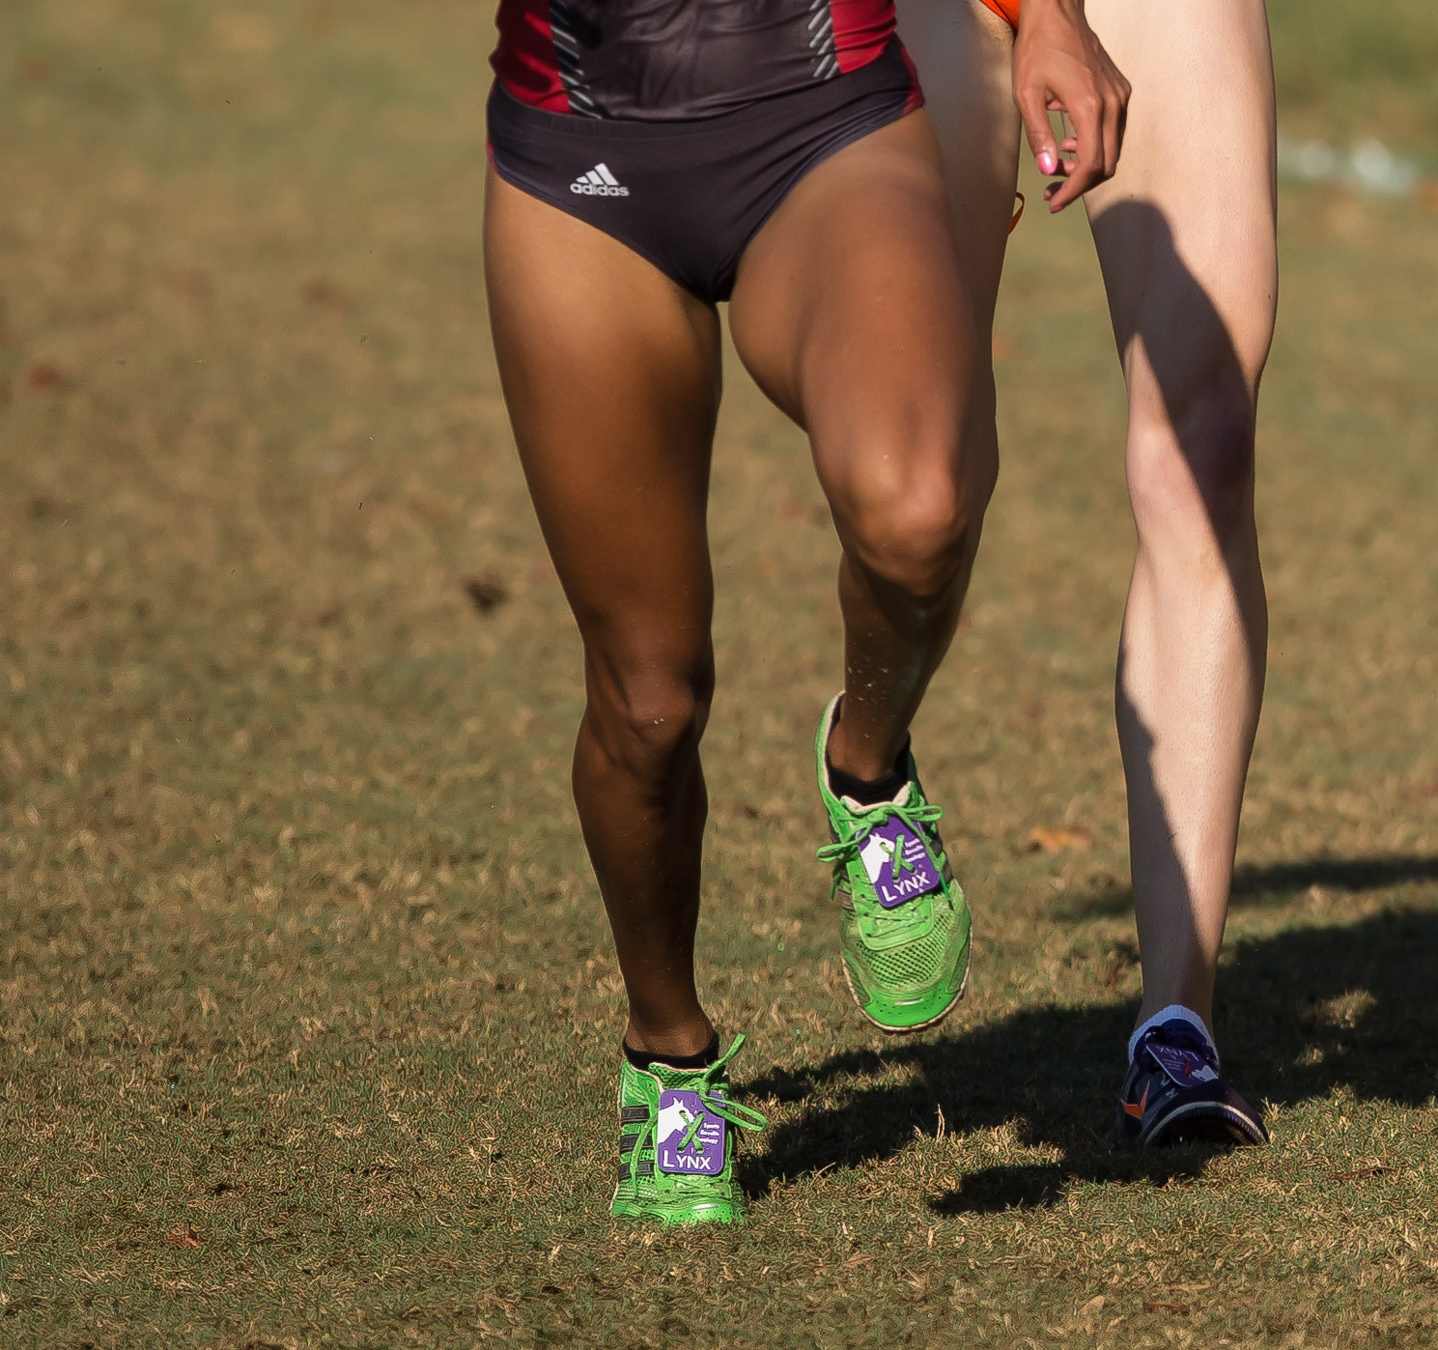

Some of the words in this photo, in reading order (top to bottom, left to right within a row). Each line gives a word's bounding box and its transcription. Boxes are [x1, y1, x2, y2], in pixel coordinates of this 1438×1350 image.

[570, 183, 630, 196] adidas
[881, 871, 931, 902] LYNX
[663, 1150, 713, 1170] LYNX
